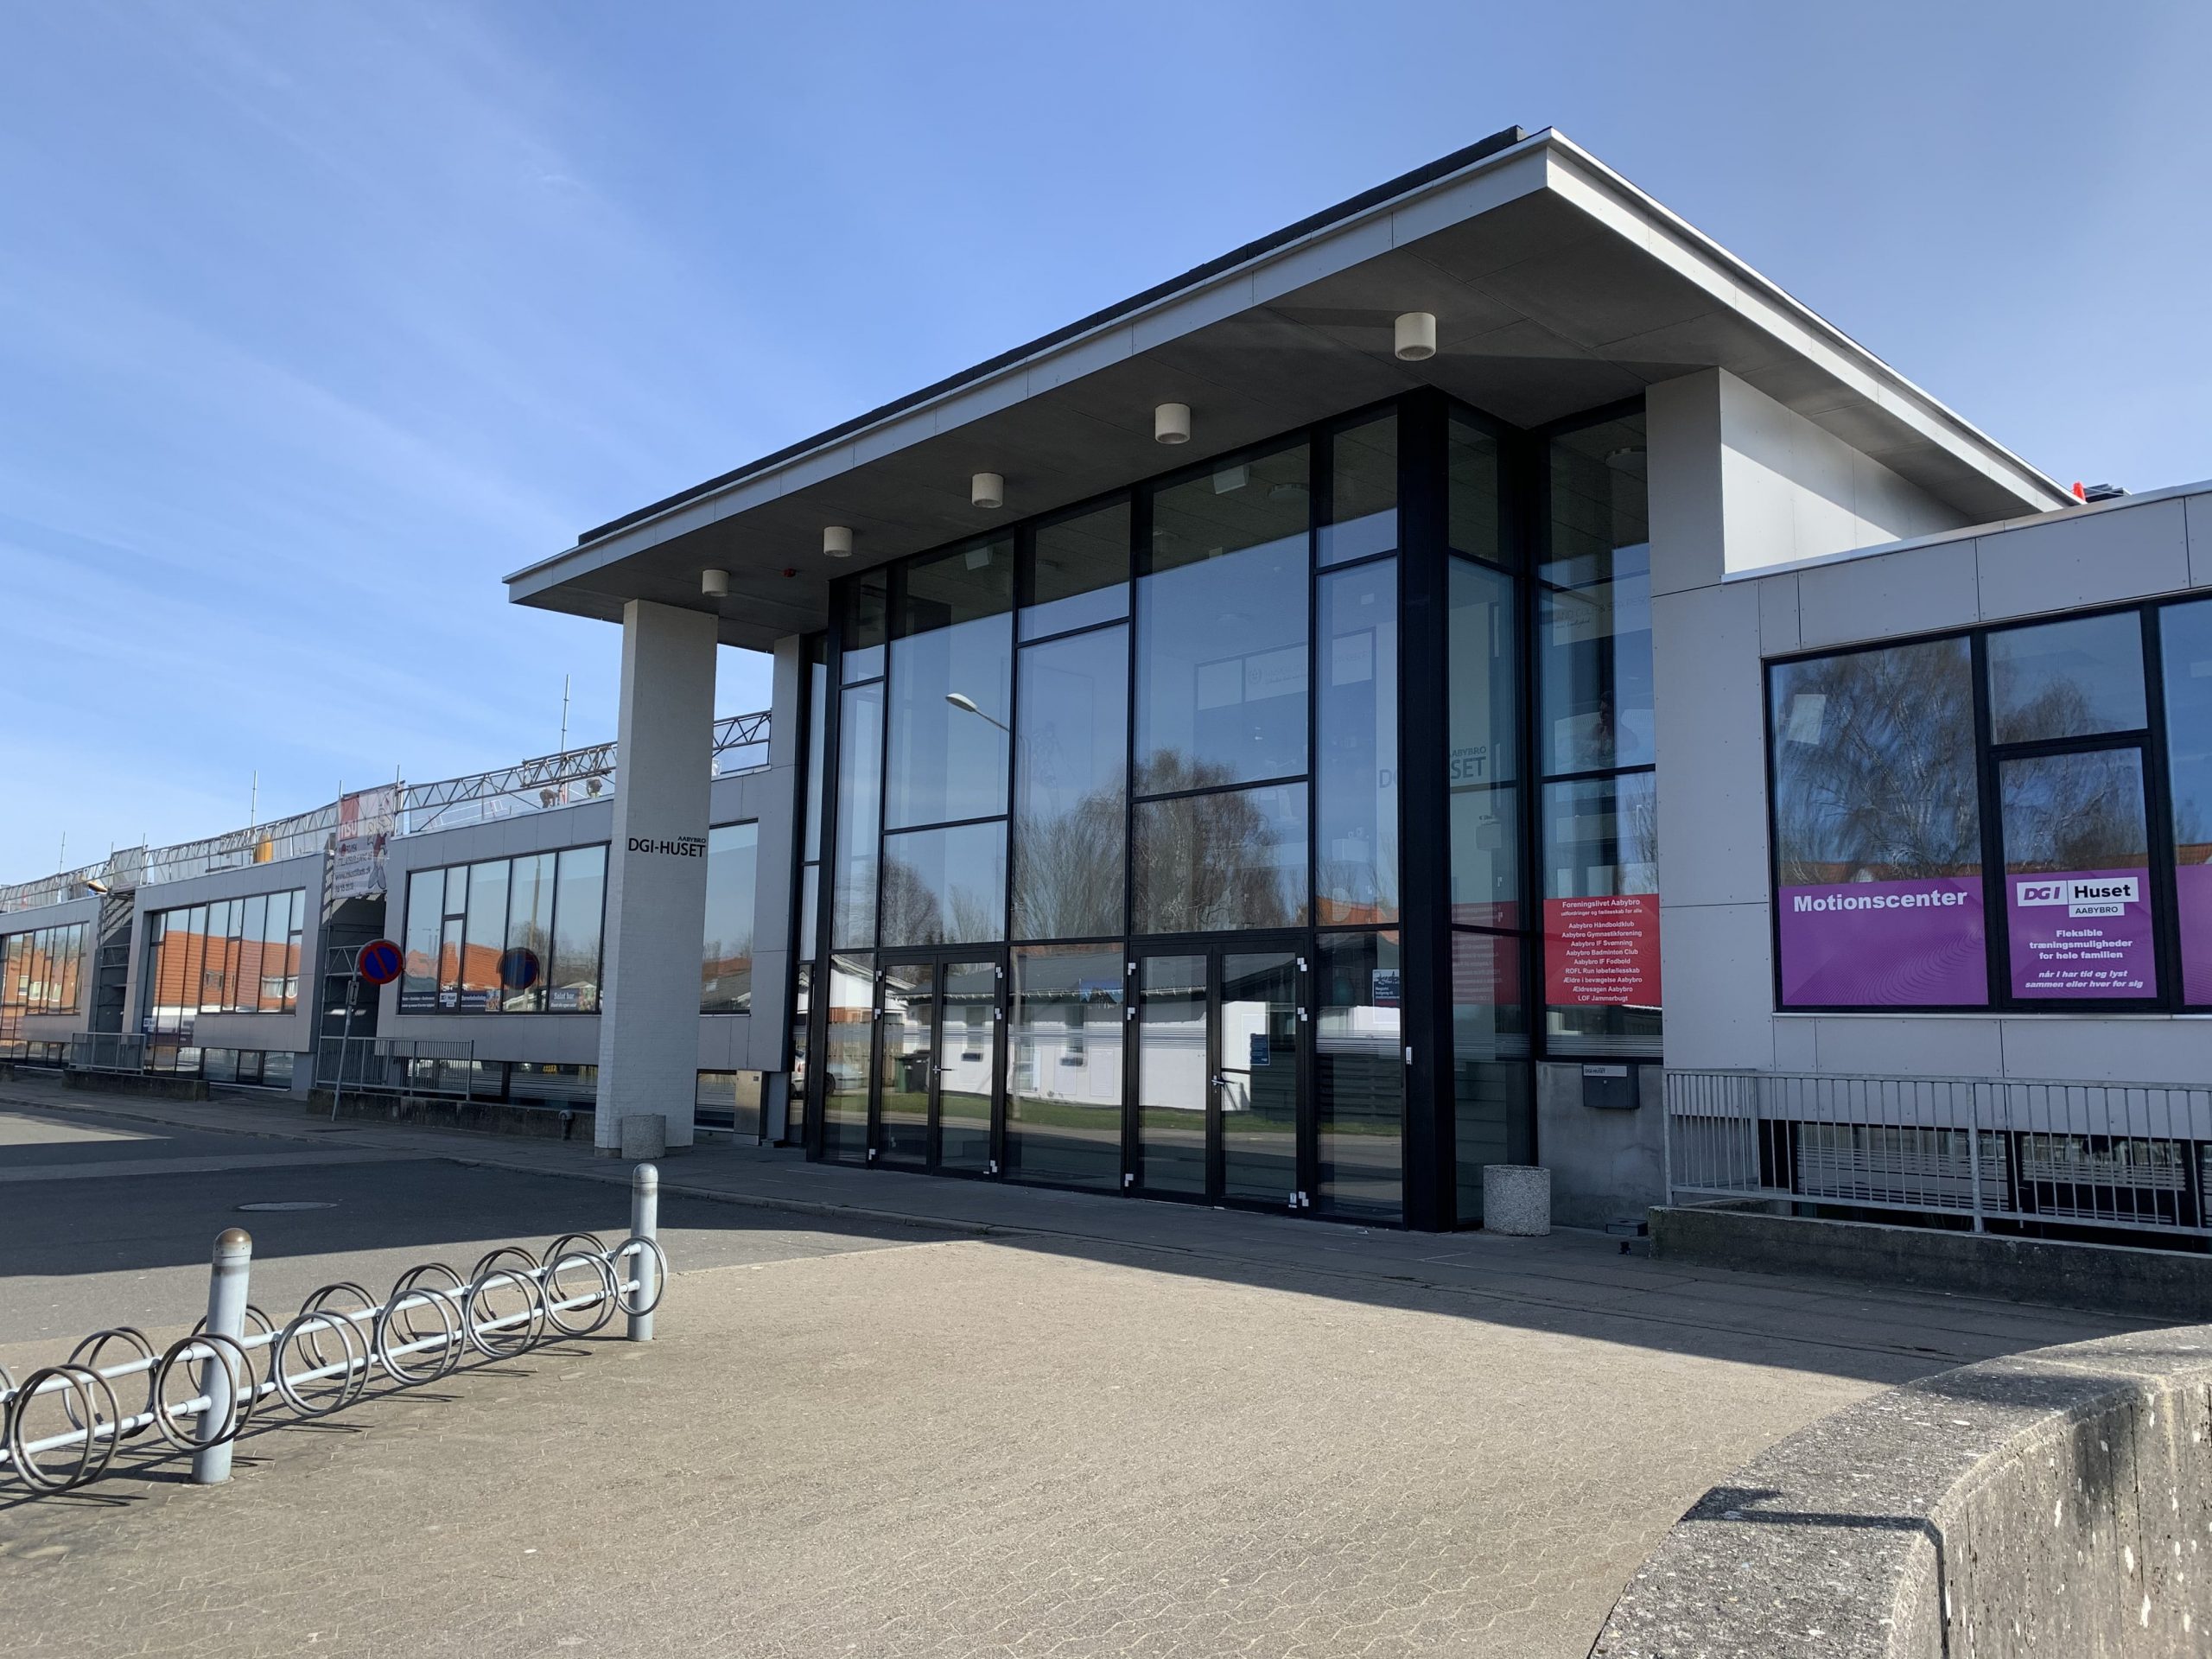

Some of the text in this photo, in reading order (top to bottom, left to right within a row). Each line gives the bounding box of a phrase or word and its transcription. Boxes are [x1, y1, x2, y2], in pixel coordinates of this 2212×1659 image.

[628, 838, 706, 857] DGI-HUSET
[1794, 889, 1968, 912] Motionscenter
[2024, 885, 2132, 901] DGI Huset
[2030, 940, 2133, 950] træningsmuligheder
[2128, 980, 2144, 988] sig
